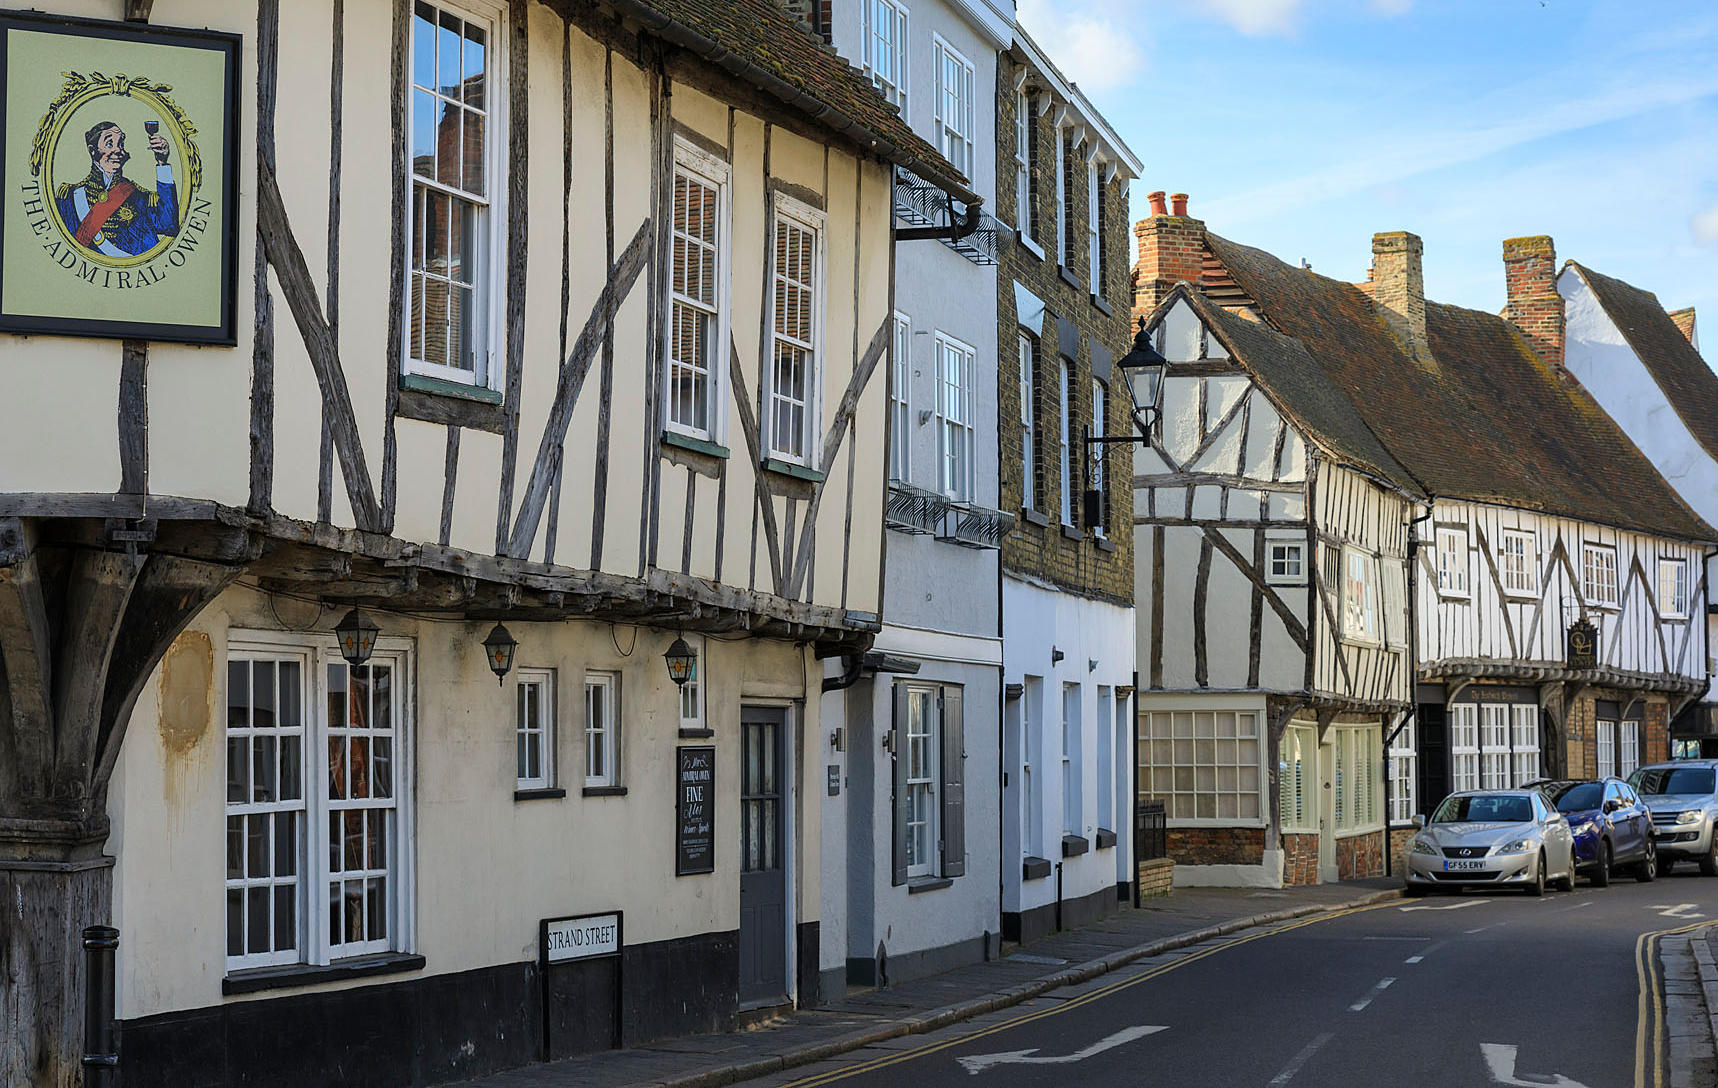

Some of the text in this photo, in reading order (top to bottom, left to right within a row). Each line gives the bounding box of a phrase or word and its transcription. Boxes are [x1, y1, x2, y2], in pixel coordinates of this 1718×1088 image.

[21, 180, 213, 289] THE ADMIRAL OWEN
[686, 786, 703, 803] FINE
[548, 925, 616, 950] STRAND STREET
